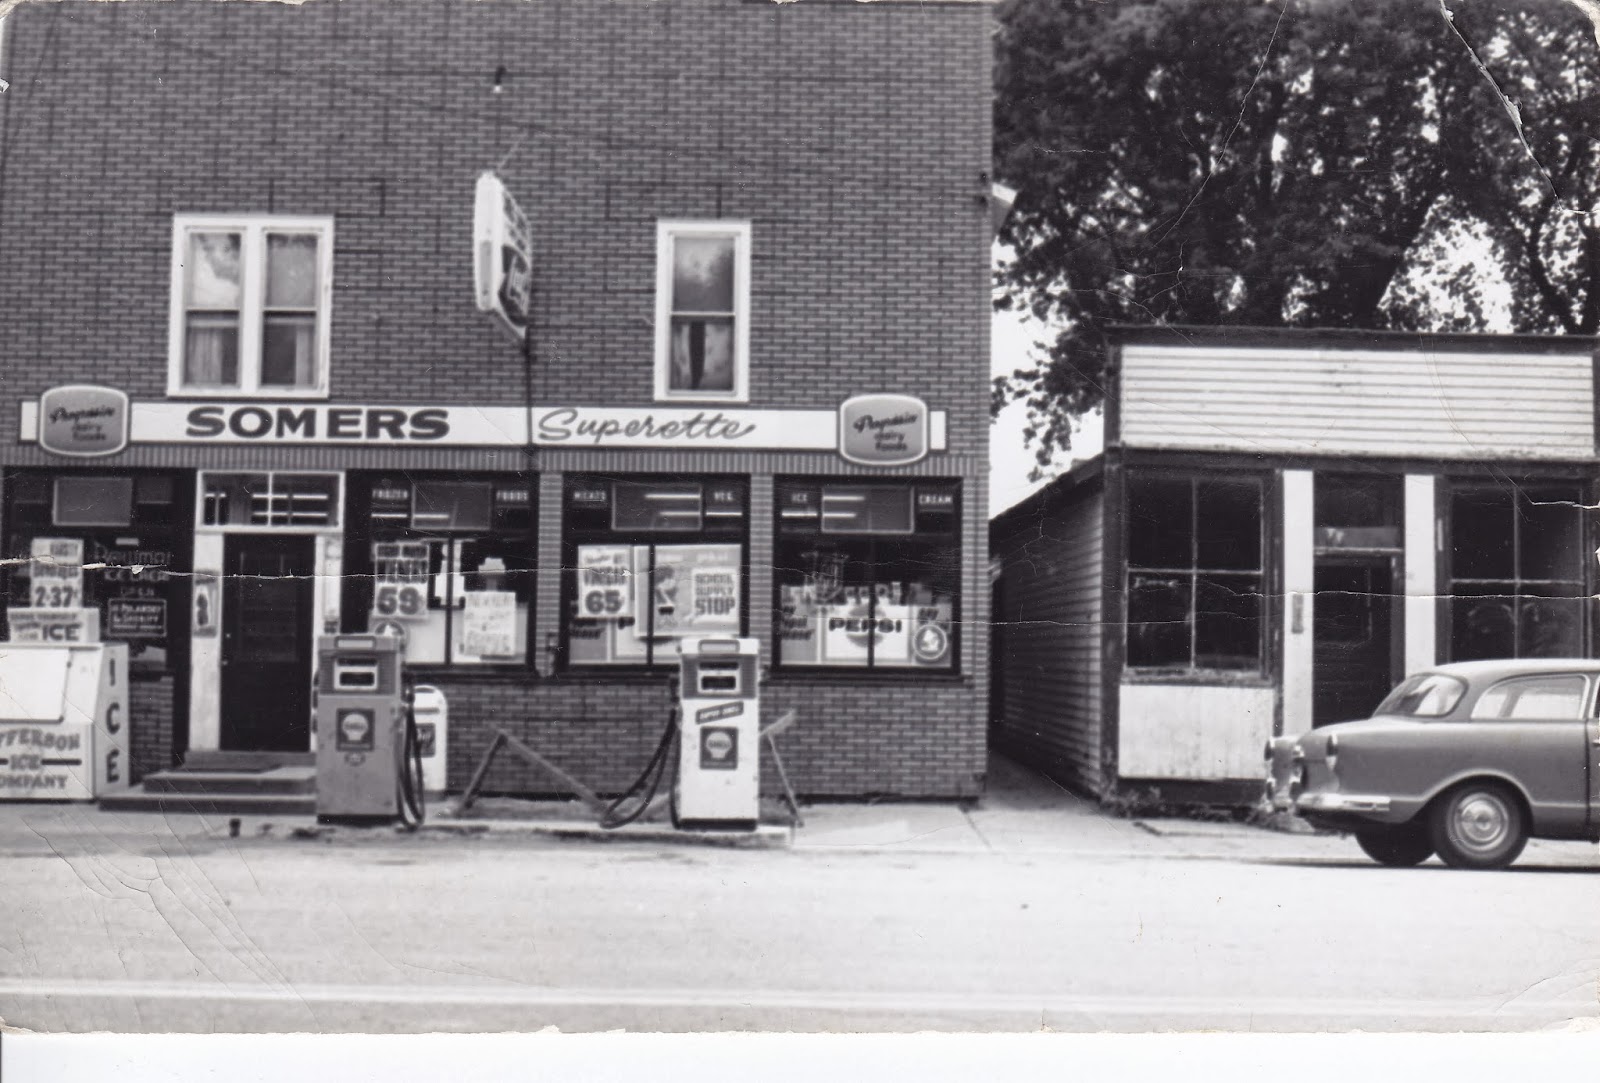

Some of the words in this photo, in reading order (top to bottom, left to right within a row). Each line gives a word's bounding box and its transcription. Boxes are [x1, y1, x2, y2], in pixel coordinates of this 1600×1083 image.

[185, 406, 450, 440] SOMERS
[537, 407, 757, 443] Superette
[574, 491, 606, 500] MEATS
[919, 495, 952, 504] CREAM
[585, 590, 620, 614] 65
[695, 597, 735, 615] STOP
[42, 623, 81, 641] ICE
[829, 618, 902, 633] PEPSI
[106, 658, 120, 784] ICE
[10, 754, 40, 771] ICE
